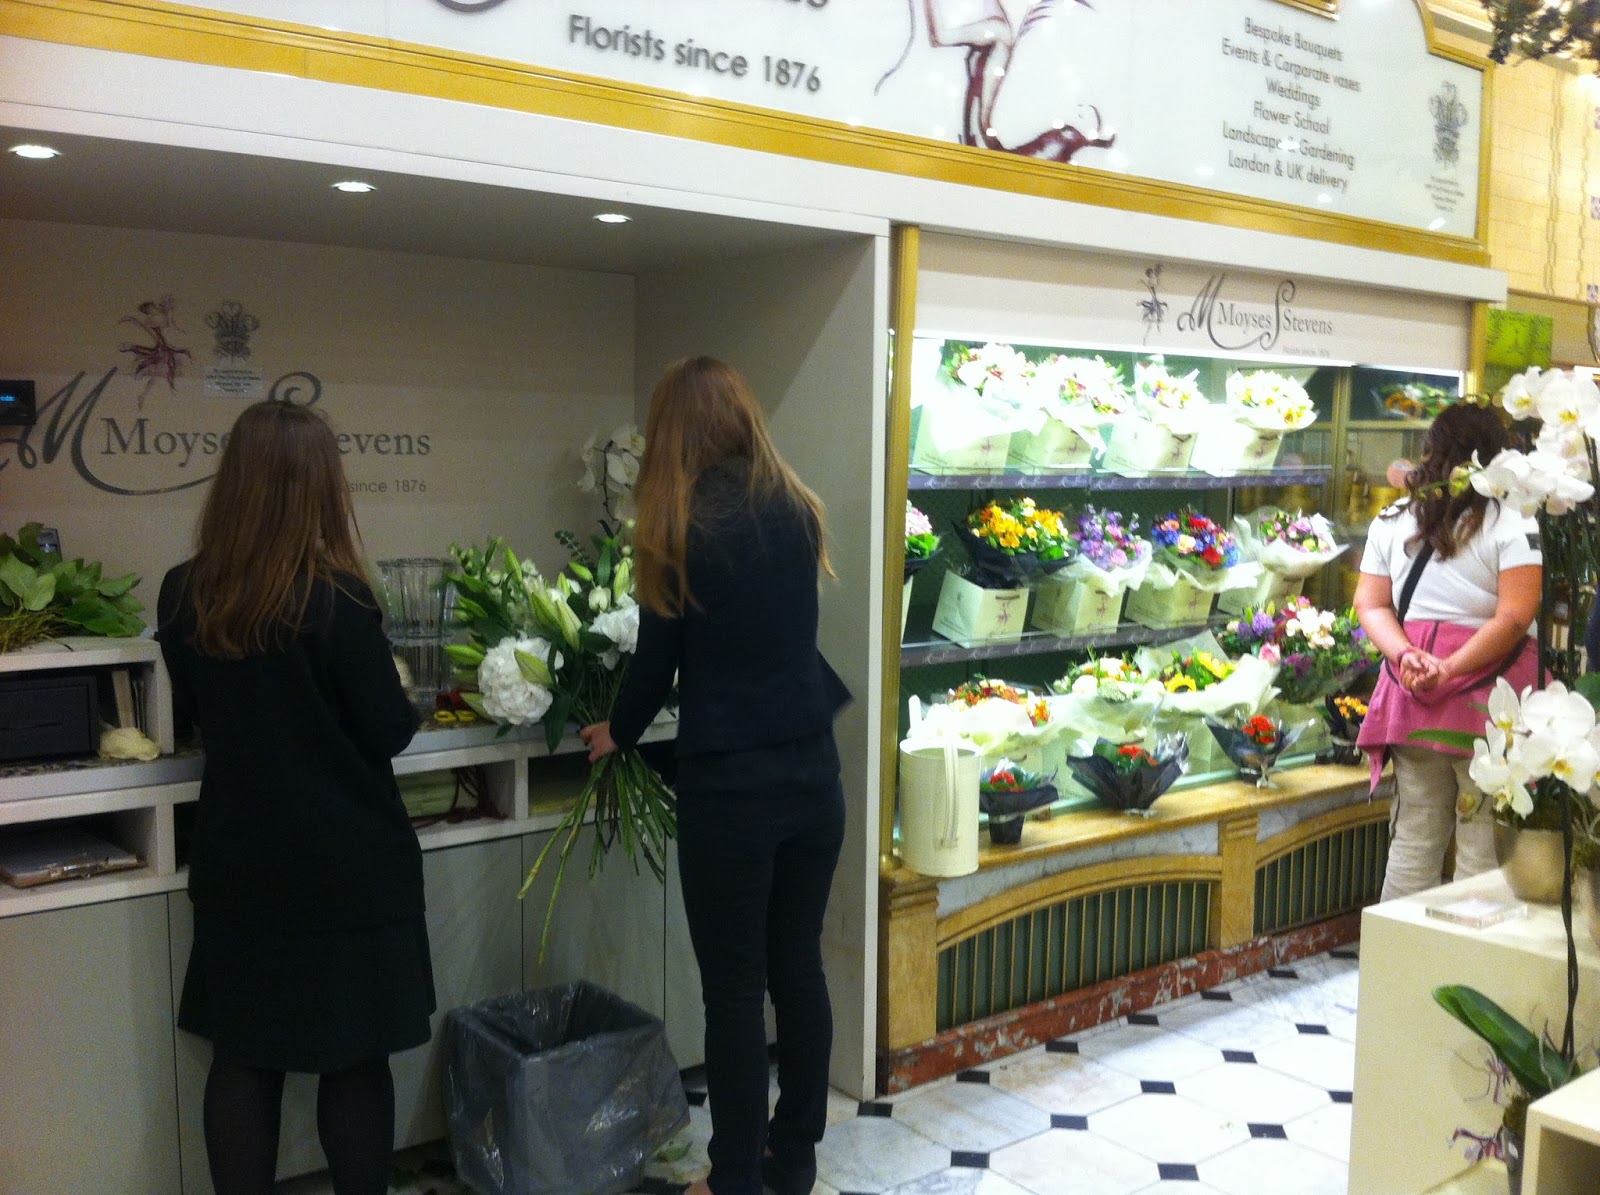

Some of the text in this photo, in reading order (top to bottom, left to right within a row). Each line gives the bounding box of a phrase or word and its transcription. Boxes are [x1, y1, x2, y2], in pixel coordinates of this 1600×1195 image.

[569, 14, 821, 93] Florists since 1876
[1244, 16, 1344, 62] Bespoke Bouquets
[1221, 37, 1259, 64] Events
[1261, 48, 1272, 67] &
[1274, 53, 1330, 81] Corporate
[1265, 77, 1322, 111] Weddings
[1253, 100, 1330, 135] Flower School
[1228, 150, 1348, 194] London & UK delivery
[1299, 138, 1356, 171] Gardening
[1217, 302, 1272, 335] Moyses
[1283, 308, 1333, 335] Stevens
[100, 417, 232, 468] Moys
[335, 432, 431, 455] evens
[348, 479, 427, 493] since 1876
